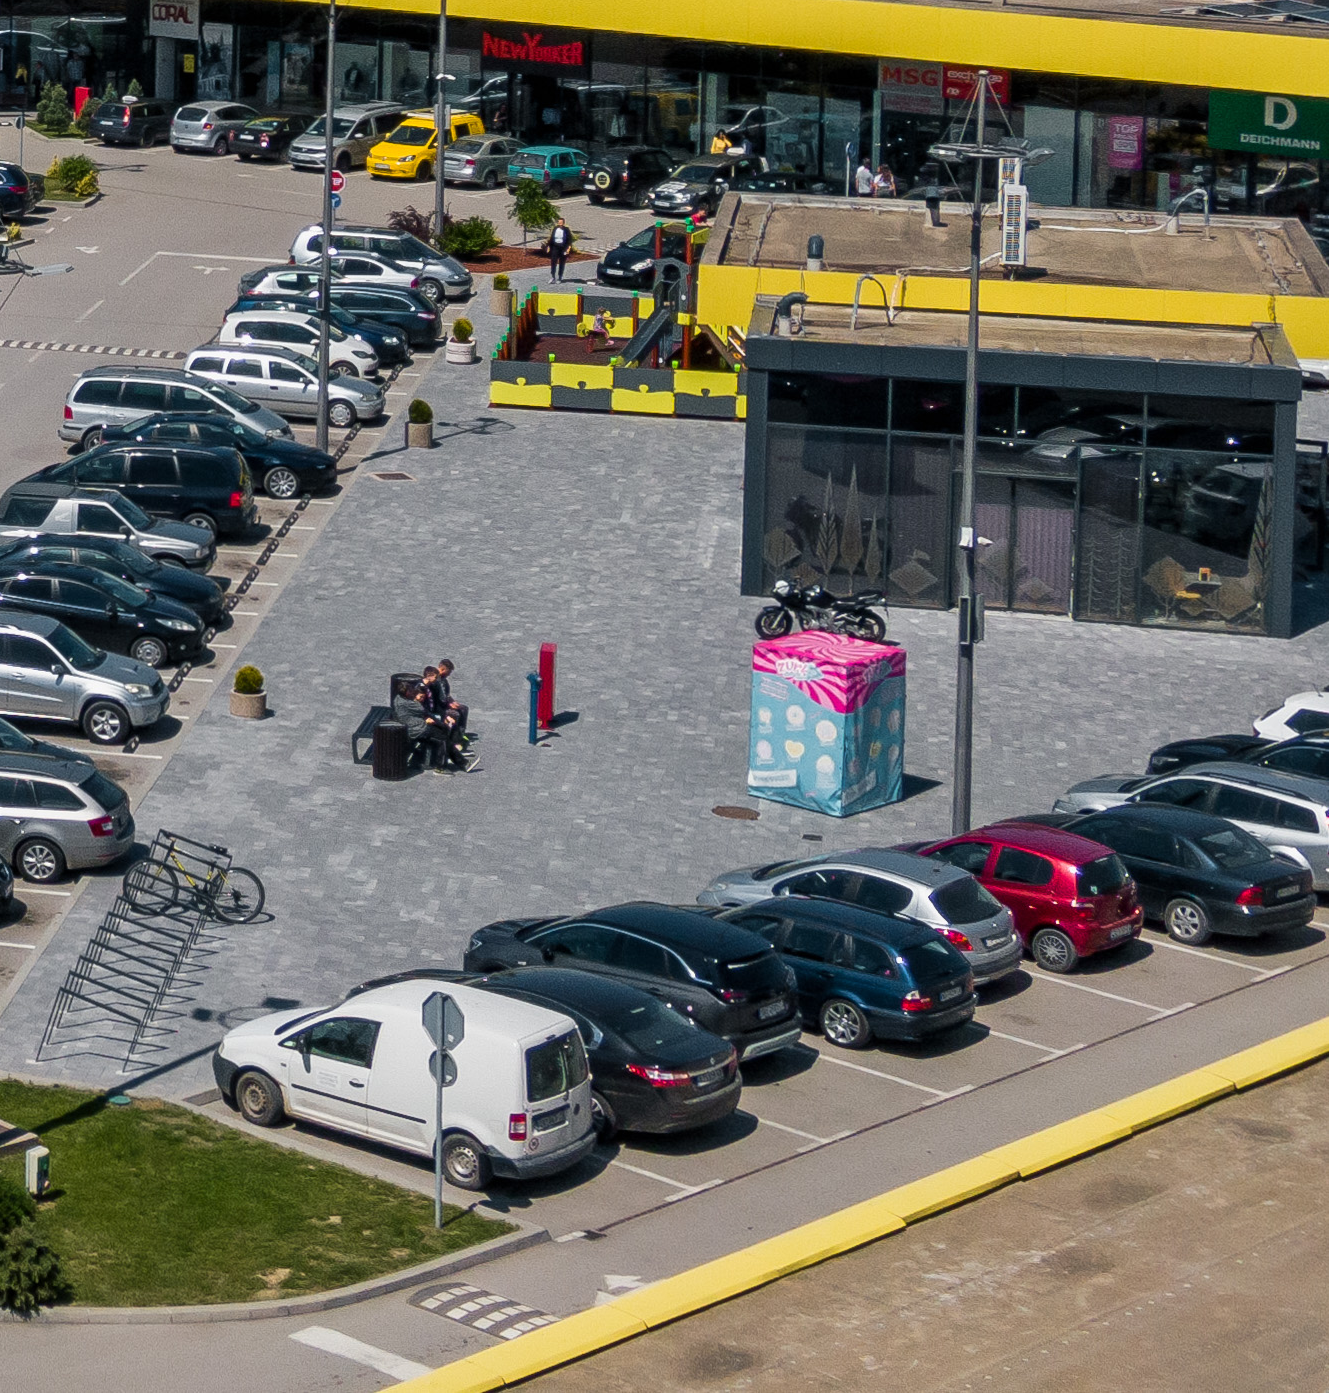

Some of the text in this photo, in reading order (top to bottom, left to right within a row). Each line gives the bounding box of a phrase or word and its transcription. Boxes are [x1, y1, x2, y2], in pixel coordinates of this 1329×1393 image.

[152, 4, 193, 24] CORAL
[882, 65, 939, 87] MSG
[1263, 96, 1298, 130] D
[1240, 133, 1321, 151] DEICHMANN
